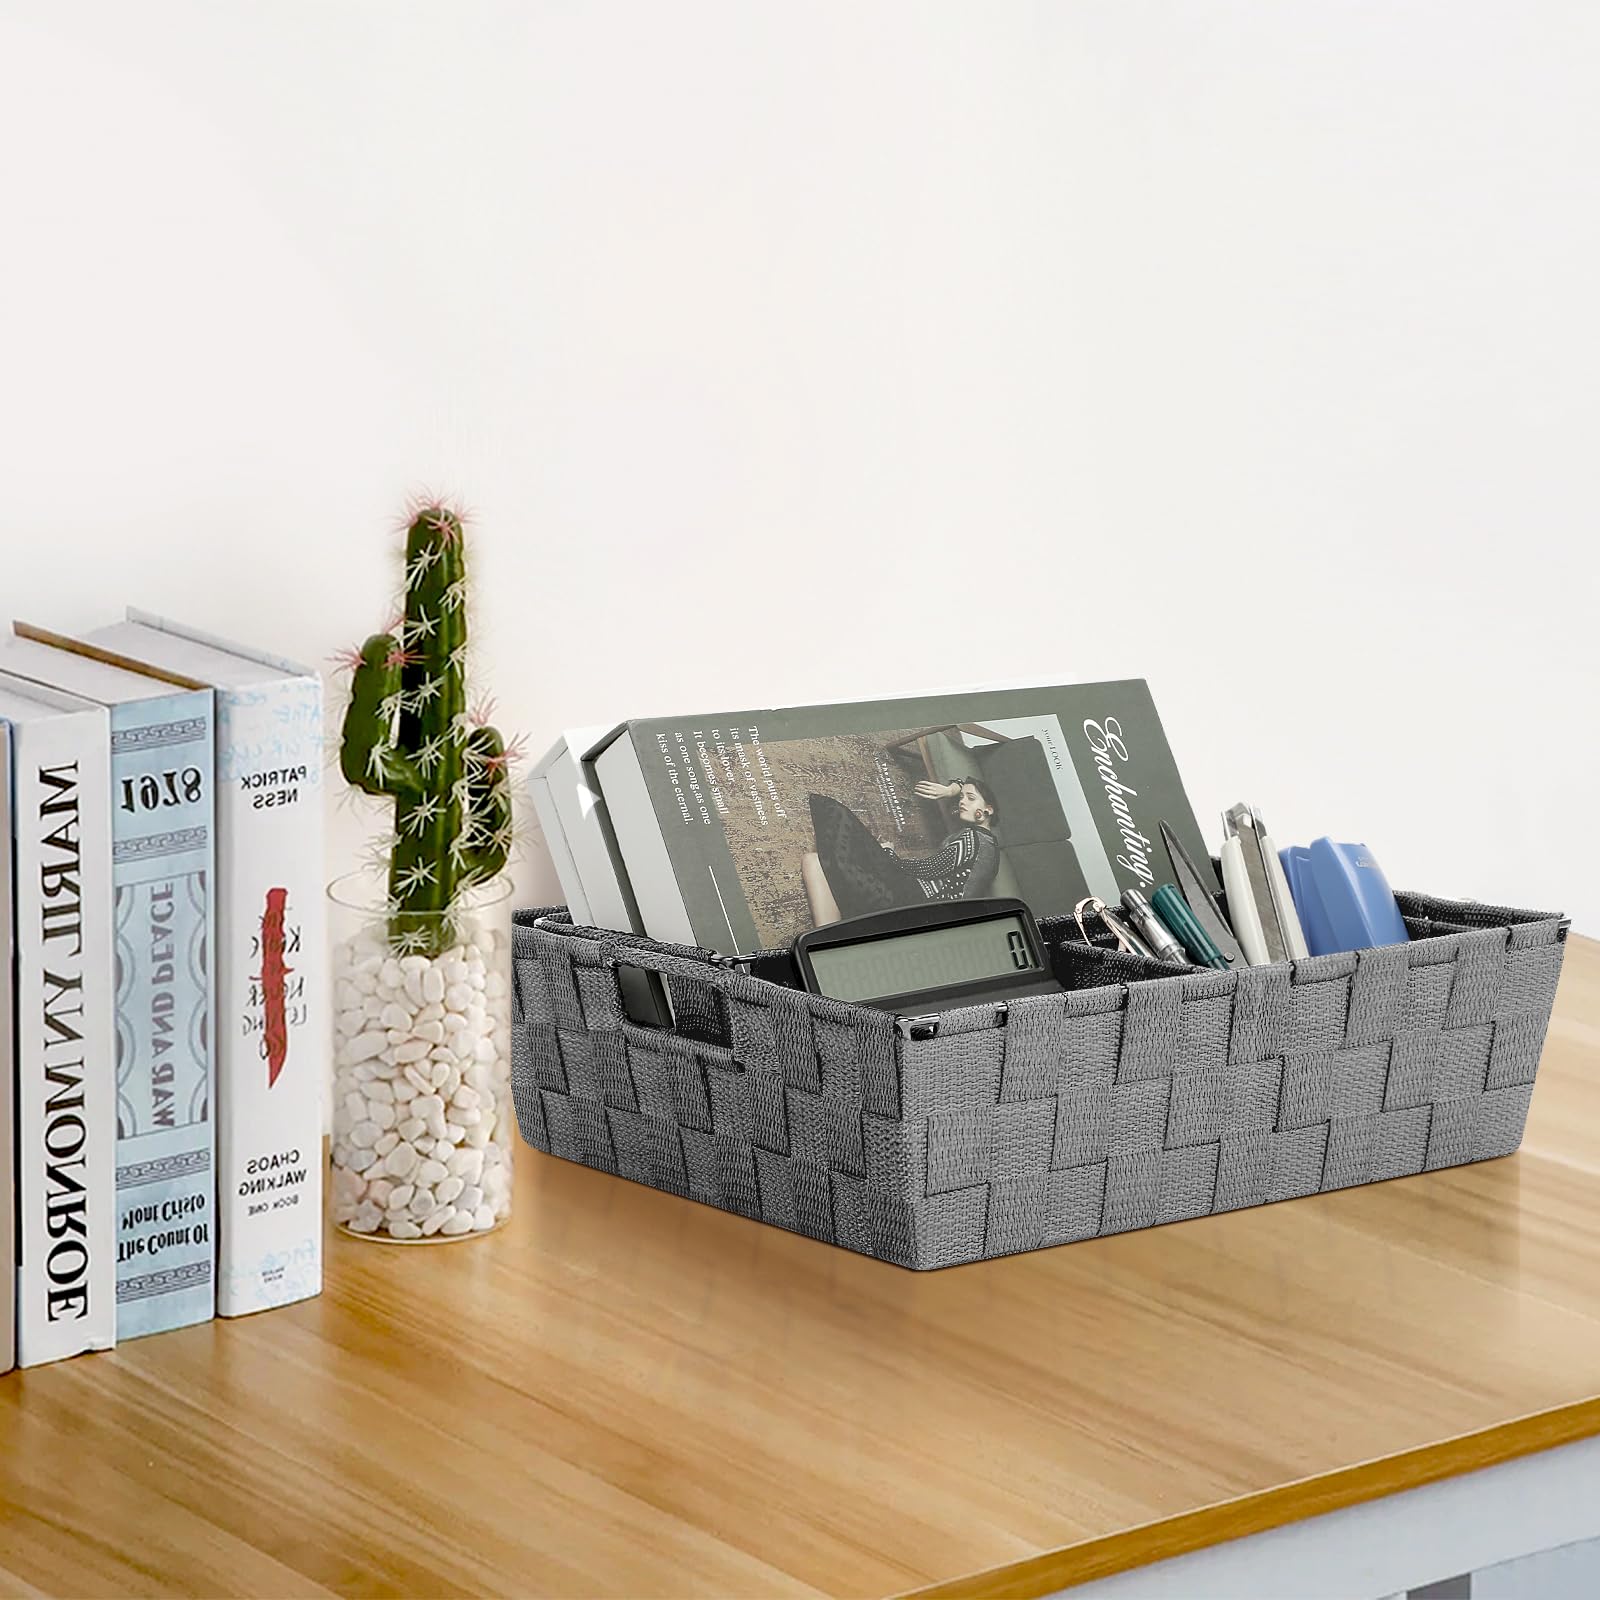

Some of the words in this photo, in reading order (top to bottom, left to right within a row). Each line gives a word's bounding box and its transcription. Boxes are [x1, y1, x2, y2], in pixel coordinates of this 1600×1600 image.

[656, 733, 669, 754] kiss
[693, 730, 703, 739] It
[712, 729, 721, 740] to
[730, 727, 740, 740] its
[716, 741, 727, 755] its
[735, 742, 751, 769] mask
[664, 755, 676, 767] of
[697, 740, 717, 785] becomes
[748, 725, 760, 746] The
[755, 747, 773, 779] world
[764, 779, 779, 801] puts
[775, 802, 787, 819] off
[668, 769, 679, 785] the
[675, 732, 684, 743] as
[680, 745, 691, 765] one
[700, 805, 711, 825] one
[745, 771, 756, 783] of
[674, 787, 694, 825] eternal.
[712, 787, 729, 815] small
[749, 784, 769, 826] vastness
[1083, 716, 1155, 888] Enchanting.
